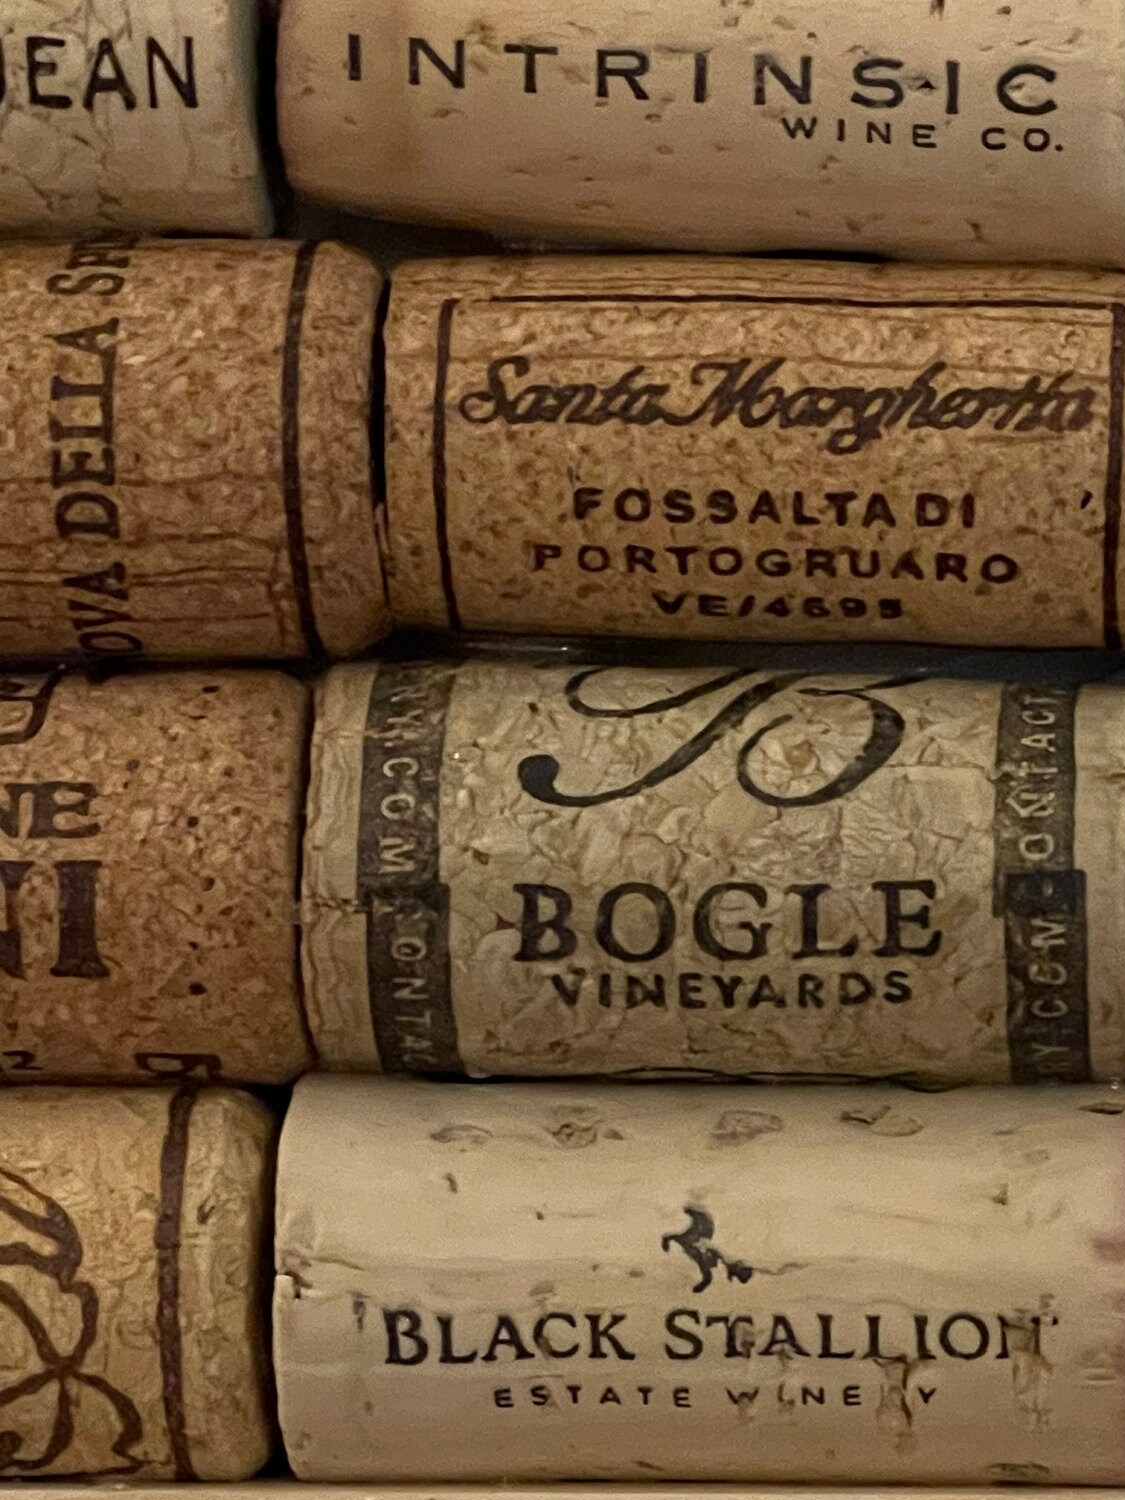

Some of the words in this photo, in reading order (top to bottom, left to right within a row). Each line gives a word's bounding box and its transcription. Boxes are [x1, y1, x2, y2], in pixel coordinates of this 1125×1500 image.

[0, 35, 200, 108] EAN
[346, 33, 1058, 117] INTRINSIC
[780, 116, 938, 149] WINE
[980, 126, 1065, 153] CO.
[48, 316, 121, 540] DELLA
[458, 354, 690, 427] Santa
[690, 354, 1099, 456] Margherita
[572, 486, 898, 530] FOSSALTA
[914, 493, 976, 529] DI
[531, 543, 1020, 584] PORTOGRUARO
[512, 881, 944, 964] BOGLE
[550, 970, 914, 1009] VINEYARDS
[383, 1309, 635, 1366] BLACK
[663, 1308, 1059, 1361] STALLION
[493, 1386, 692, 1408] ESTATE
[726, 1384, 938, 1408] WINEY
